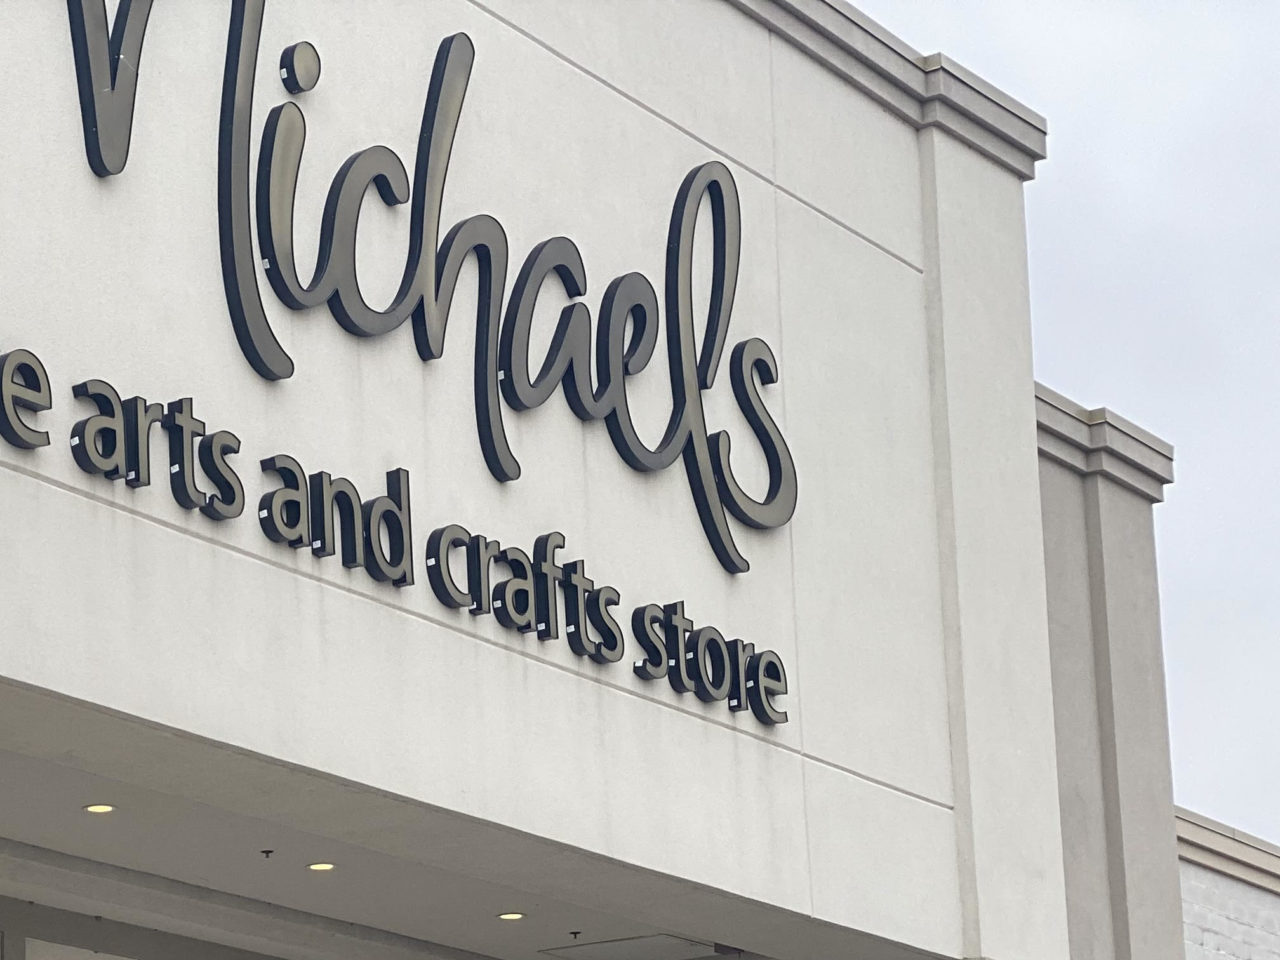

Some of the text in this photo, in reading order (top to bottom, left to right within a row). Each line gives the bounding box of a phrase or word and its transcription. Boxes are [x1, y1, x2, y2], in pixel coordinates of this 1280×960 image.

[70, 379, 246, 521] arts
[259, 454, 415, 587] and
[426, 523, 625, 665] crafts
[632, 600, 789, 725] store
